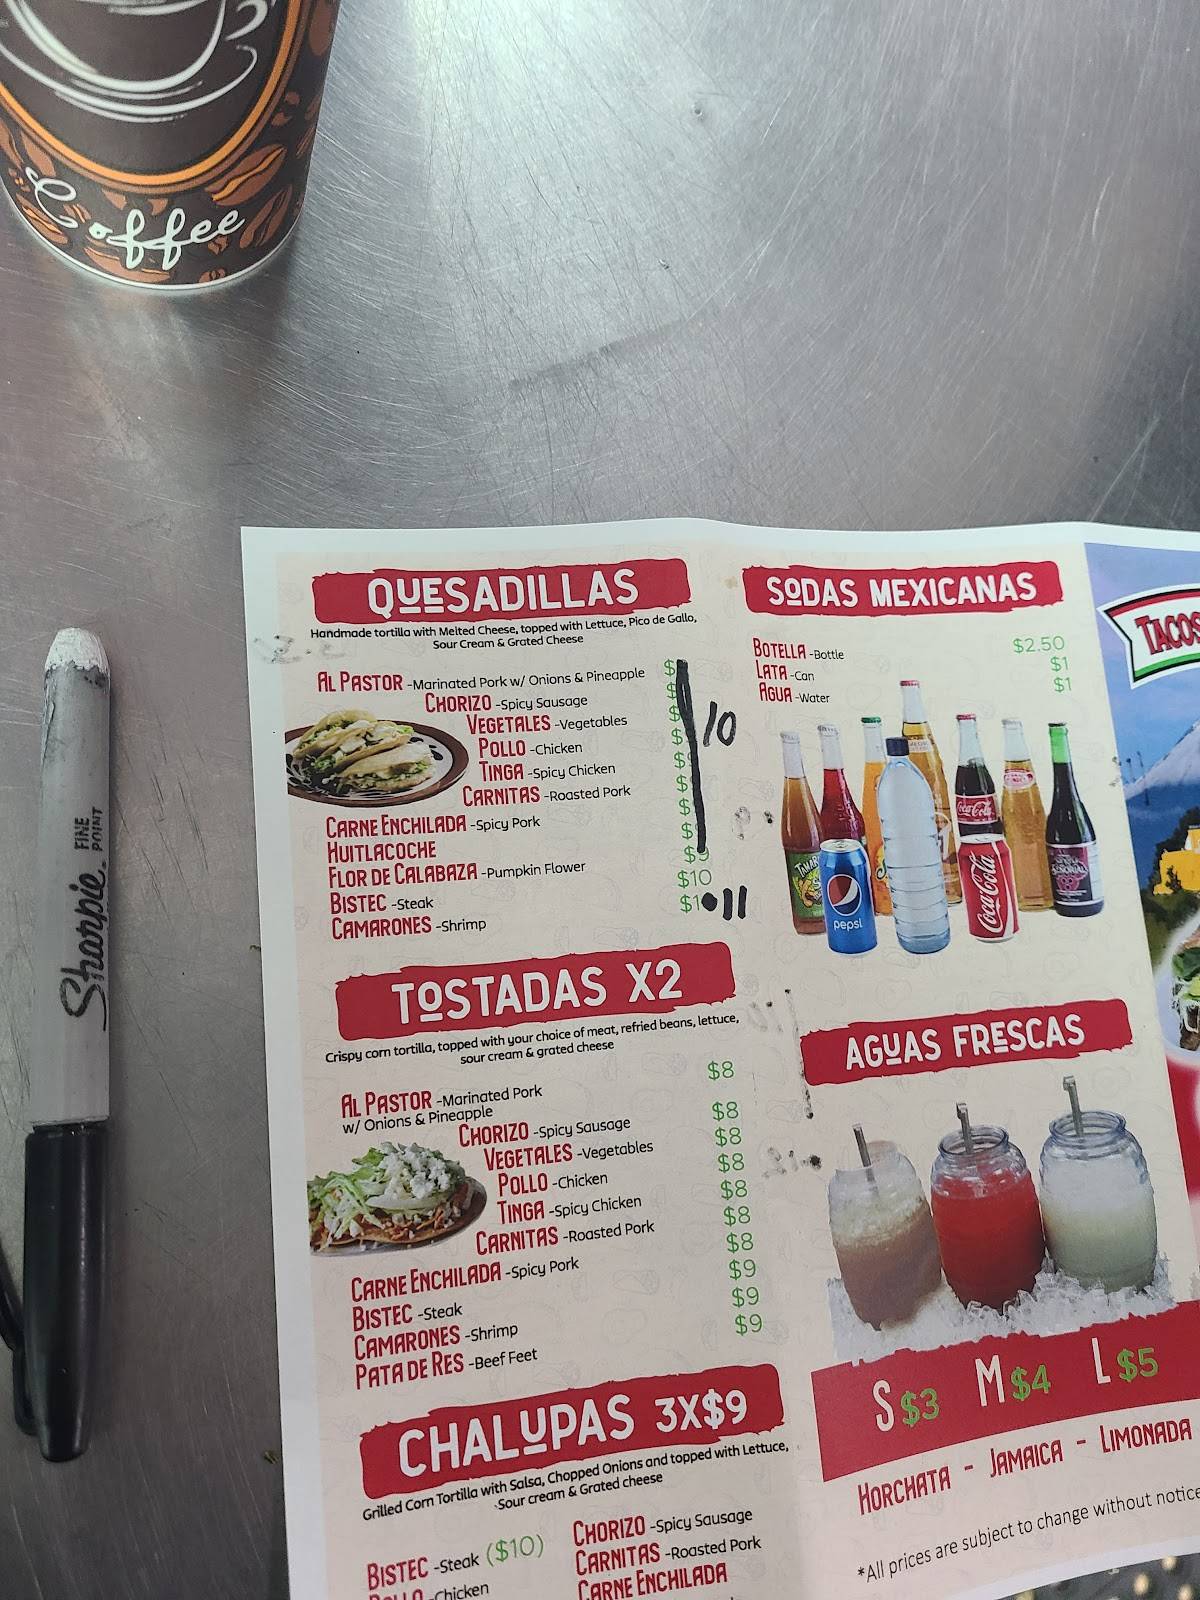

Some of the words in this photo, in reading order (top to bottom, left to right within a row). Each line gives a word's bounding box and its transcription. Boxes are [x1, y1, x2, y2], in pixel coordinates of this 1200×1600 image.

[25, 166, 245, 271] Coffee
[367, 568, 639, 619] QUESADILLAS
[766, 576, 857, 607] SODAS
[870, 572, 1037, 607] MEXICANAS
[310, 628, 372, 638] Handmade
[374, 626, 411, 637] tortilla
[413, 626, 436, 636] with
[439, 625, 475, 636] Melted
[477, 623, 518, 636] Cheese,
[520, 623, 558, 635] topped
[560, 620, 583, 632] with
[585, 618, 626, 631] Lettuce,
[629, 616, 650, 627] Pico
[652, 615, 665, 626] de
[667, 613, 697, 625] Gallo,
[433, 639, 457, 650] Sour
[460, 638, 495, 649] Cream
[497, 638, 505, 647] &
[508, 636, 543, 647] Grated
[546, 634, 583, 645] Cheese
[753, 637, 806, 659] BOTELLA
[1012, 636, 1065, 654] $2.50
[1050, 657, 1069, 672] $1
[480, 675, 507, 688] Pork
[509, 675, 526, 687] w/
[529, 672, 571, 686] Onions
[574, 672, 583, 684] &
[587, 667, 645, 683] Pineapple
[1053, 678, 1071, 694] $1
[425, 693, 491, 713] CHORIZO
[537, 695, 588, 711] Sausage
[467, 714, 550, 735] VEGETALES
[479, 738, 526, 758] POLLO
[479, 760, 524, 782] TINGA
[568, 763, 616, 777] Chicken
[462, 786, 540, 806] CARNITAS
[605, 784, 631, 798] Pork
[74, 818, 89, 850] FINE
[92, 806, 103, 851] POINT
[325, 816, 379, 838] CARNE
[381, 815, 466, 837] ENCHILADA
[512, 815, 540, 829] Pork
[328, 841, 436, 863] HUITLACOCHE
[328, 867, 368, 888] FLOR
[394, 863, 477, 885] CALABAZA
[544, 861, 586, 875] Flower
[677, 870, 712, 888] $10
[330, 893, 387, 914] BISTEC
[331, 917, 431, 940] CAMARONES
[834, 919, 863, 932] pepsi
[391, 967, 607, 1024] TOSTADAS
[625, 959, 682, 1003] X2
[325, 1050, 362, 1065] Crispy
[364, 1046, 390, 1059] corn
[394, 1044, 435, 1058] tortilla,
[438, 1039, 478, 1054] topped
[481, 1035, 505, 1049] with
[508, 1033, 533, 1046] your
[536, 1027, 570, 1042] choice
[573, 1026, 584, 1038] of
[586, 1024, 618, 1038] meat,
[621, 1020, 657, 1033] refried
[660, 1017, 696, 1030] beans,
[698, 1013, 739, 1026] lettuce,
[846, 1029, 941, 1070] AGUAS
[952, 1014, 1085, 1058] FRESCAS
[460, 1053, 484, 1065] sour
[487, 1048, 523, 1061] cream
[526, 1047, 534, 1057] &
[537, 1044, 575, 1060] grated
[578, 1039, 614, 1053] cheese
[708, 1061, 734, 1080] $8
[512, 1085, 543, 1099] Pork
[343, 1121, 361, 1134] w/
[364, 1113, 412, 1131] Onions
[415, 1112, 426, 1126] &
[429, 1106, 493, 1125] Pineapple
[712, 1101, 739, 1121] $8
[459, 1122, 528, 1148] CHORIZO
[576, 1118, 631, 1136] Sausage
[715, 1127, 741, 1146] $8
[484, 1144, 573, 1170] VEGETALES
[718, 1153, 745, 1173] $8
[498, 1172, 548, 1197] POLLO
[721, 1179, 747, 1199] $8
[498, 1200, 545, 1224] TINGA
[592, 1195, 642, 1211] Chicken
[724, 1206, 750, 1226] $8
[476, 1226, 559, 1255] CARNITAS
[625, 1220, 655, 1234] Pork
[727, 1232, 753, 1253] $8
[352, 1274, 407, 1302] CARNE
[411, 1262, 501, 1293] ENCHILADA
[549, 1257, 579, 1272] Pork
[729, 1259, 756, 1280] $9
[732, 1287, 759, 1307] $9
[352, 1304, 412, 1331] BISTEC
[735, 1314, 762, 1335] $9
[354, 1325, 460, 1360] CAMARONES
[508, 1348, 537, 1363] Feet
[872, 1380, 894, 1432] S
[901, 1388, 939, 1427] $3
[975, 1355, 1005, 1406] M
[1010, 1365, 1051, 1401] $4
[1092, 1338, 1111, 1384] L
[1117, 1348, 1158, 1382] $5
[399, 1394, 634, 1477] CHALUPAS
[655, 1390, 747, 1432] 3X$9
[858, 1466, 951, 1515] HORCHATA
[990, 1440, 1063, 1478] JAMAICA
[1100, 1418, 1192, 1453] LIMONADA
[362, 1504, 403, 1521] Grilled
[406, 1497, 433, 1512] Corn
[437, 1489, 478, 1507] Tortilla
[481, 1483, 508, 1498] with
[510, 1478, 546, 1493] Salsa,
[548, 1468, 599, 1489] Chopped
[602, 1459, 643, 1476] Onions
[646, 1456, 667, 1469] and
[670, 1450, 712, 1470] topped
[715, 1445, 740, 1459] with
[742, 1440, 789, 1458] Lettuce,
[498, 1494, 526, 1510] Sour
[528, 1491, 565, 1504] cream
[568, 1485, 577, 1497] &
[580, 1479, 619, 1496] Grated
[622, 1473, 663, 1487] cheese
[573, 1516, 645, 1546] CHORIZO
[695, 1509, 752, 1528] Sausage
[889, 1550, 931, 1578] prices
[935, 1539, 958, 1558] are
[962, 1523, 1014, 1555] subject
[1018, 1520, 1033, 1535] to
[1037, 1505, 1088, 1531] change
[1093, 1494, 1152, 1516] without
[367, 1556, 428, 1591] BISTEC
[486, 1534, 544, 1568] ($10)
[575, 1542, 660, 1576] CARNITAS
[730, 1536, 761, 1551] Pork
[637, 1563, 727, 1596] ENCHILADA
